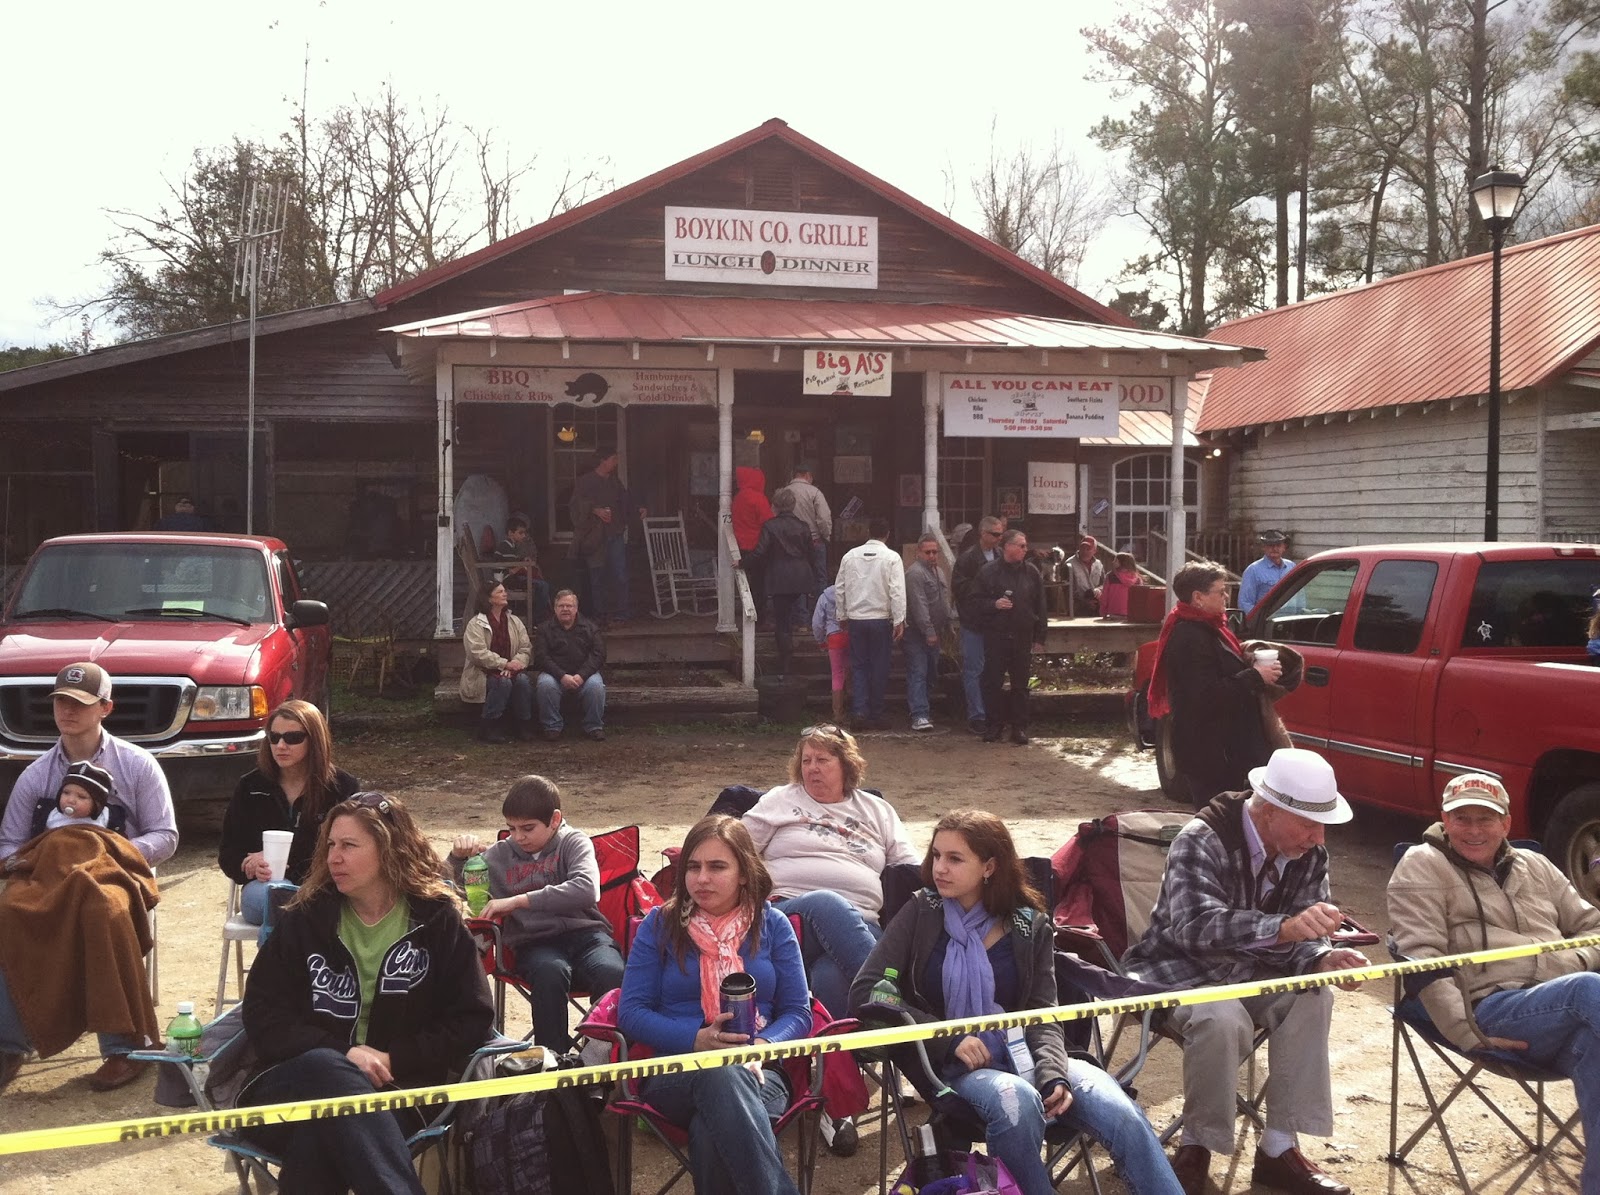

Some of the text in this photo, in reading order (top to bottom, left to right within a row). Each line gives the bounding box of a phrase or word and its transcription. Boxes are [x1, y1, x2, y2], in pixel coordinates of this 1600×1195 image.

[675, 216, 869, 247] BOYKIN CO. GRILLE
[673, 253, 870, 273] LUNCH DINNER
[816, 351, 851, 375] Big
[487, 369, 530, 388] BBQ
[950, 380, 1113, 391] ALL YOU CAN EAT
[463, 390, 553, 401] Chicken & Ribs
[1033, 476, 1069, 489] Hours
